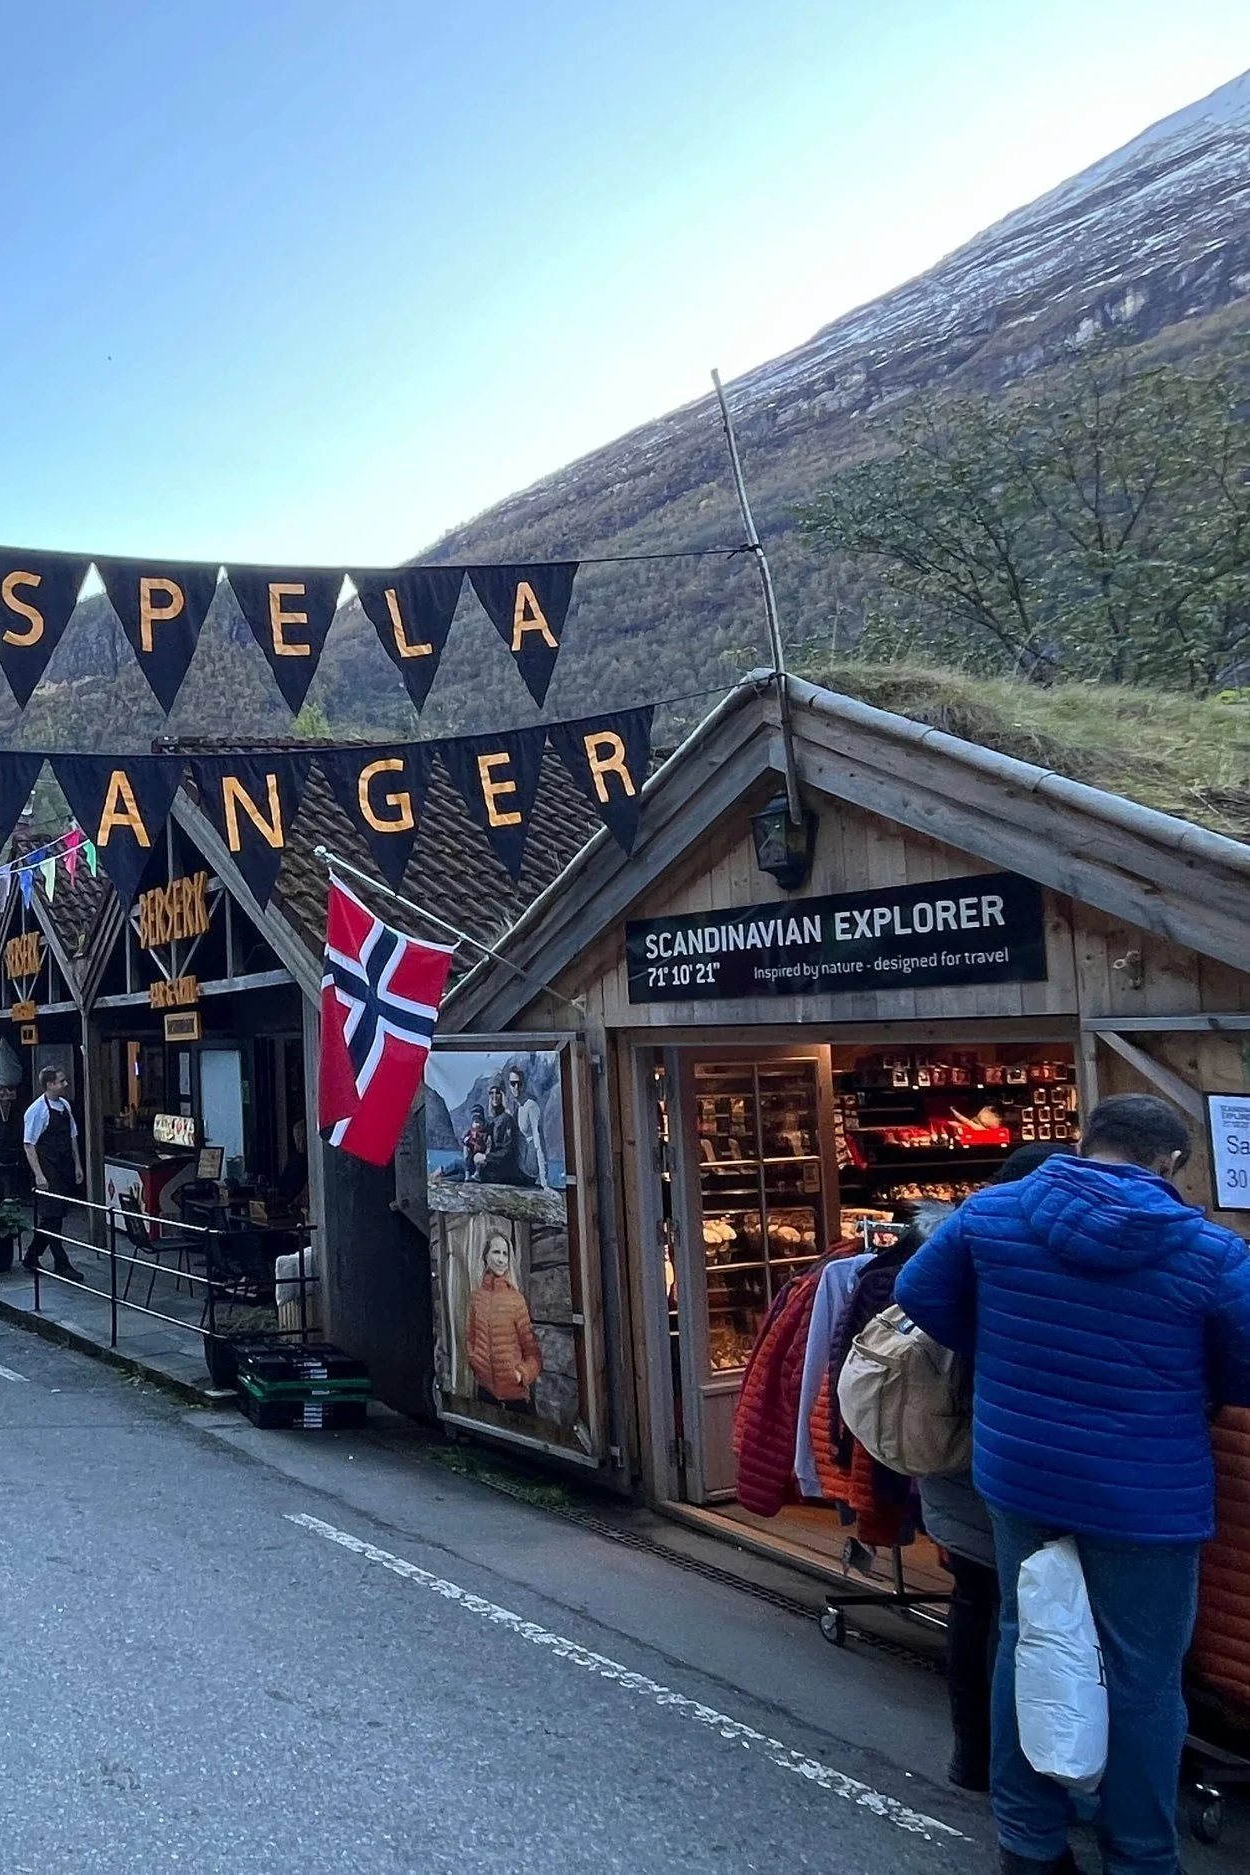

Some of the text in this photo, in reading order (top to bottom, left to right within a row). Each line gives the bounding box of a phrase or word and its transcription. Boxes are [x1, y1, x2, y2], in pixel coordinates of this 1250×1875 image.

[138, 871, 209, 949] BERSERK
[645, 895, 1006, 959] SCANDINAVIAN EXPLORER
[753, 964, 801, 981] Inspired
[803, 963, 820, 979] by
[821, 958, 864, 975] nature
[873, 951, 938, 974] designed
[940, 950, 962, 967] for
[964, 946, 1009, 965] travel
[1226, 1168, 1248, 1189] 30
